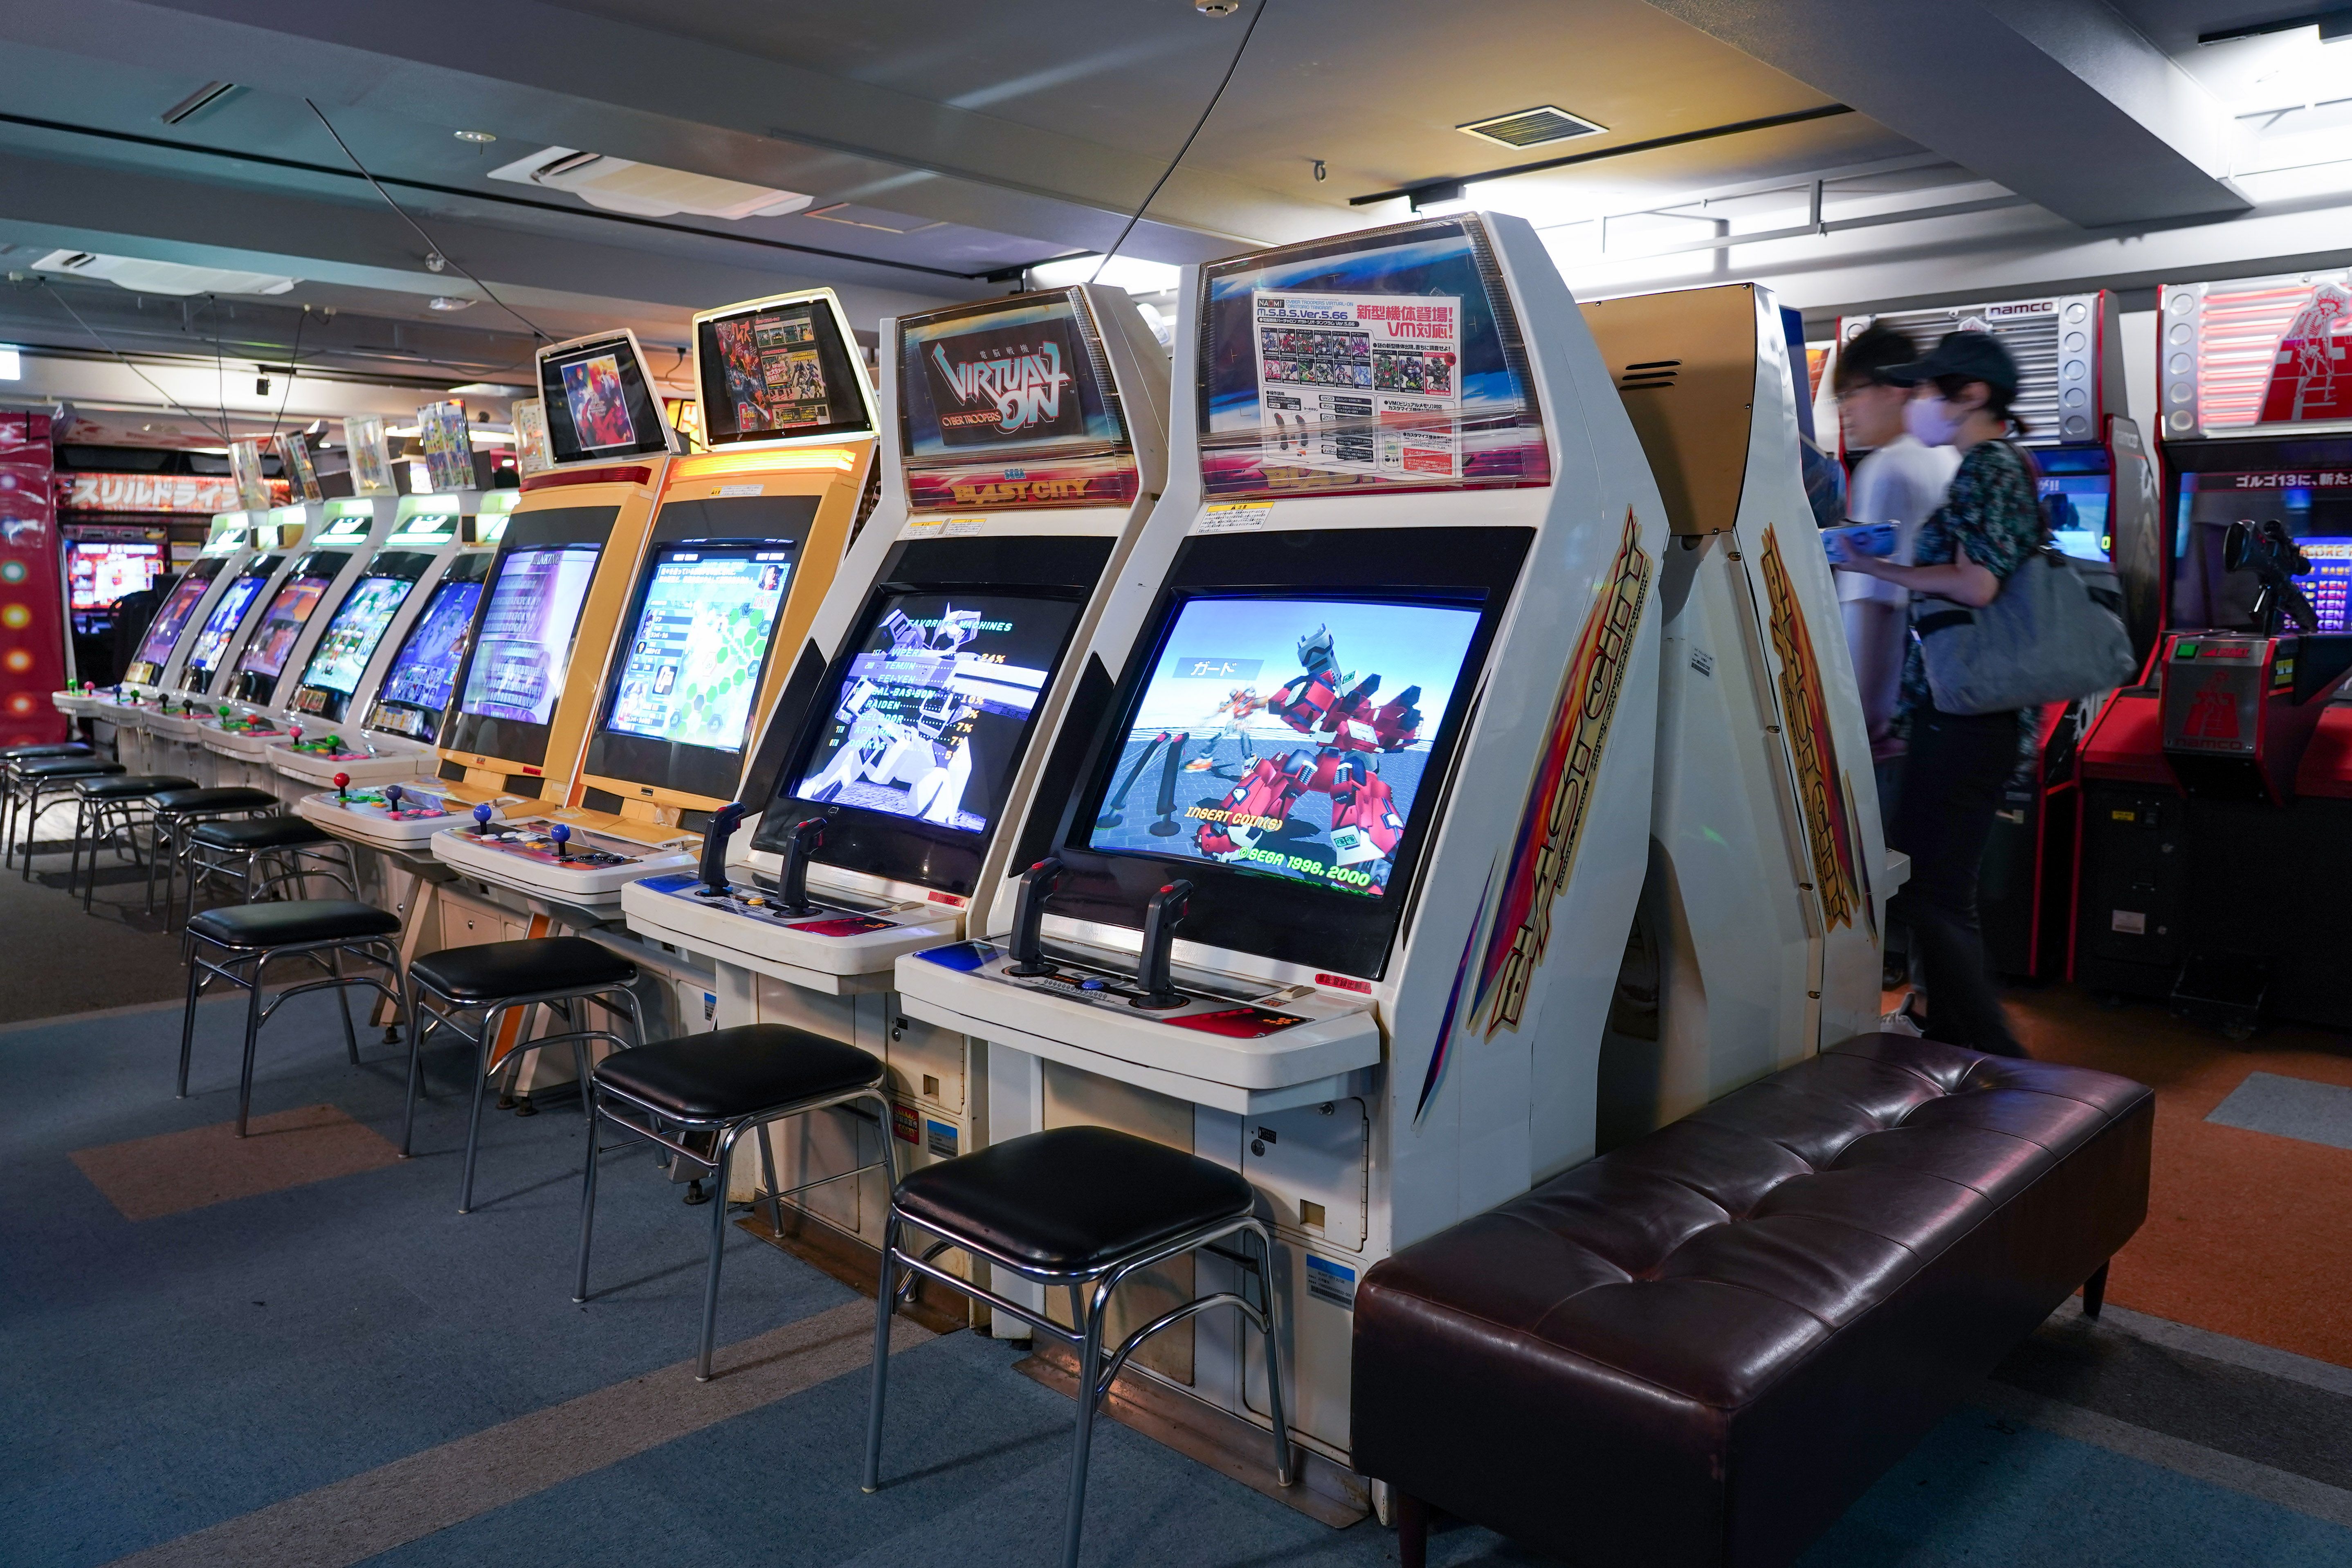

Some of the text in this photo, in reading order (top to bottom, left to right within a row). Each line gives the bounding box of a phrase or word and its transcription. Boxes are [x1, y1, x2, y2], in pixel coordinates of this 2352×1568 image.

[1357, 305, 1453, 322] 新型機体登場!
[1990, 302, 2053, 315] namco
[1387, 322, 1453, 339] VM対応!
[980, 344, 1029, 359] 電脳戦機
[932, 341, 1072, 403] VIRTUAL
[997, 384, 1059, 429] ON
[942, 411, 1001, 427] CYBER TROOPERS
[1004, 469, 1026, 480] SEGA
[949, 480, 1093, 504] BLAST CITY
[531, 553, 562, 565] RANKING
[2319, 580, 2348, 590] KEN
[2318, 590, 2347, 600] KEN
[2316, 600, 2346, 609] KEN
[1584, 504, 1646, 719] CITY
[2315, 610, 2345, 619] KEN
[906, 619, 1013, 632] FAVORITE MACHINES
[2317, 620, 2344, 630] KEN
[885, 661, 916, 670] TEMJIN
[981, 654, 1006, 664] 24%
[1190, 660, 1237, 676] ガード
[877, 674, 916, 684] FEI-YEN
[960, 694, 984, 705] 10%
[865, 701, 979, 719] RAIDEN 9%
[956, 722, 974, 733] 7%
[848, 739, 887, 750] DORKAS
[2175, 738, 2242, 750] namco
[1184, 806, 1284, 832] INSERT COIN(S)
[1286, 856, 1325, 876] 1998,
[1326, 865, 1371, 887] 2000
[1486, 717, 1596, 1037] BLAST
